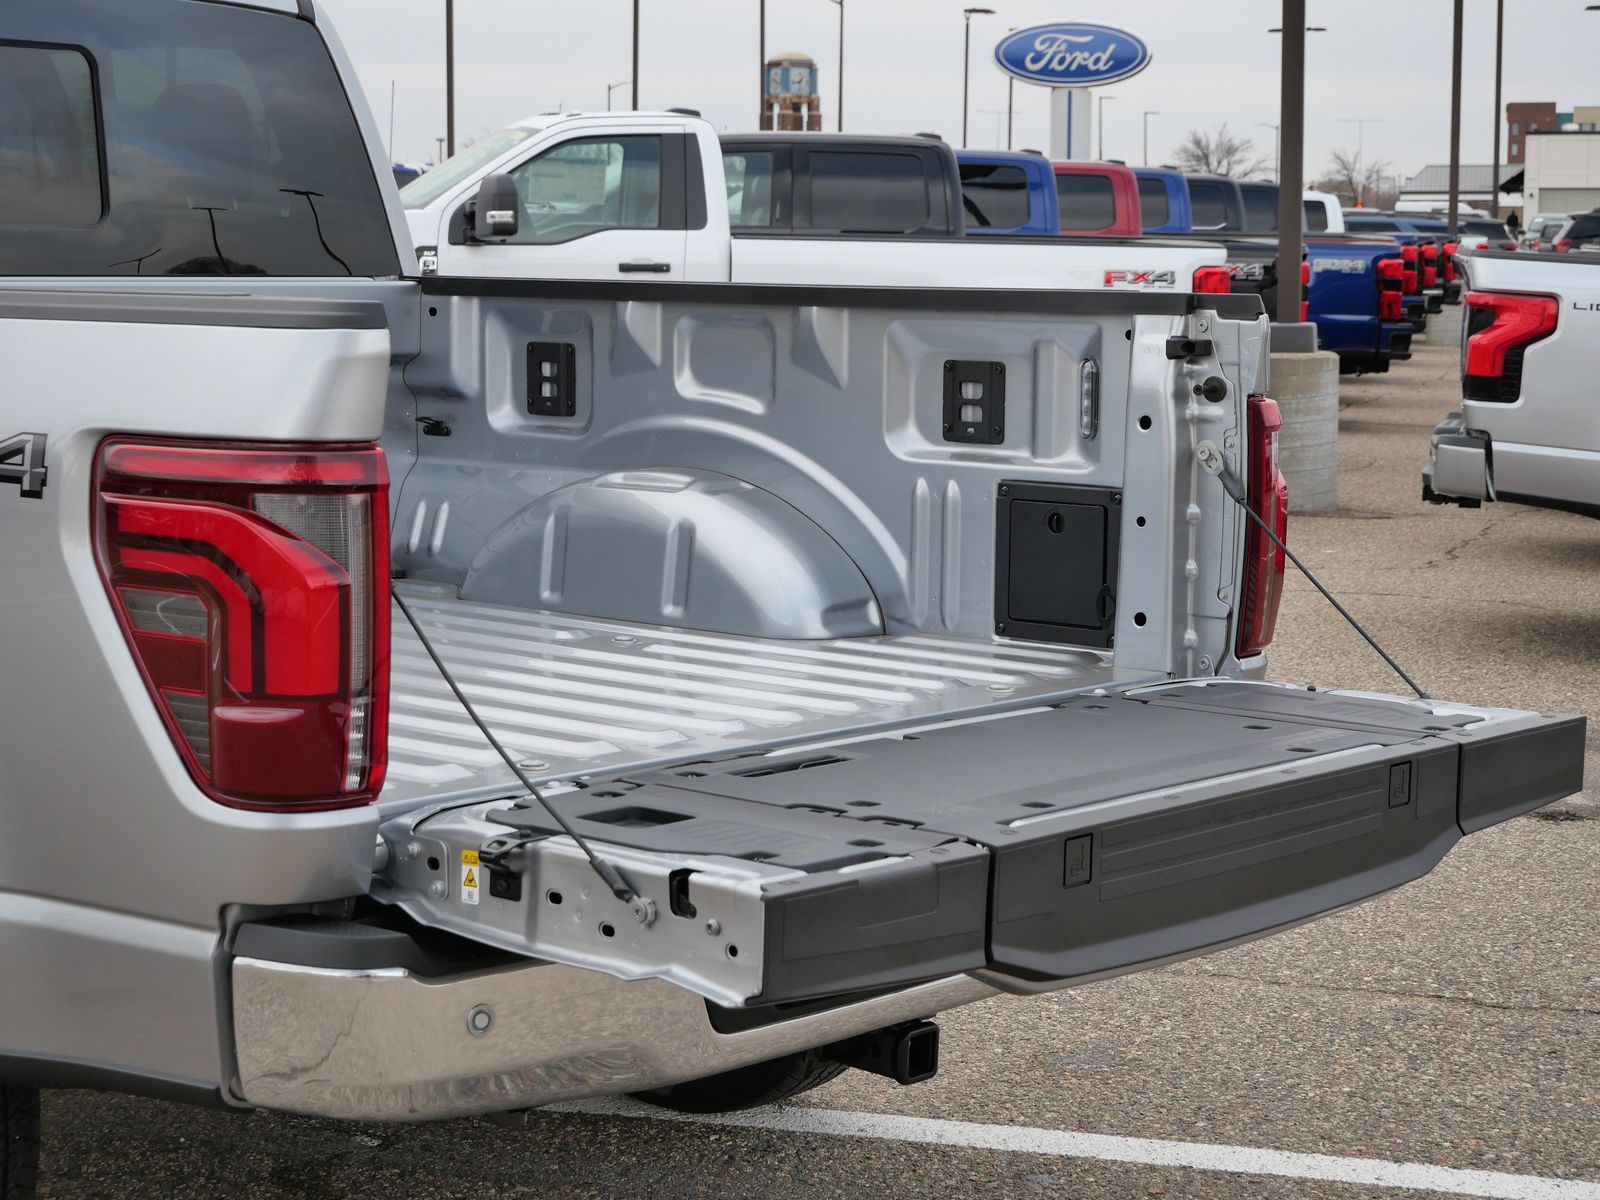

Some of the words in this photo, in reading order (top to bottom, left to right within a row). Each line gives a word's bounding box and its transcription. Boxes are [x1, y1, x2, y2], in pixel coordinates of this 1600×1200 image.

[1024, 33, 1117, 71] Ford
[1104, 270, 1176, 287] FX4
[1225, 263, 1264, 279] X4
[1573, 302, 1600, 311] LI
